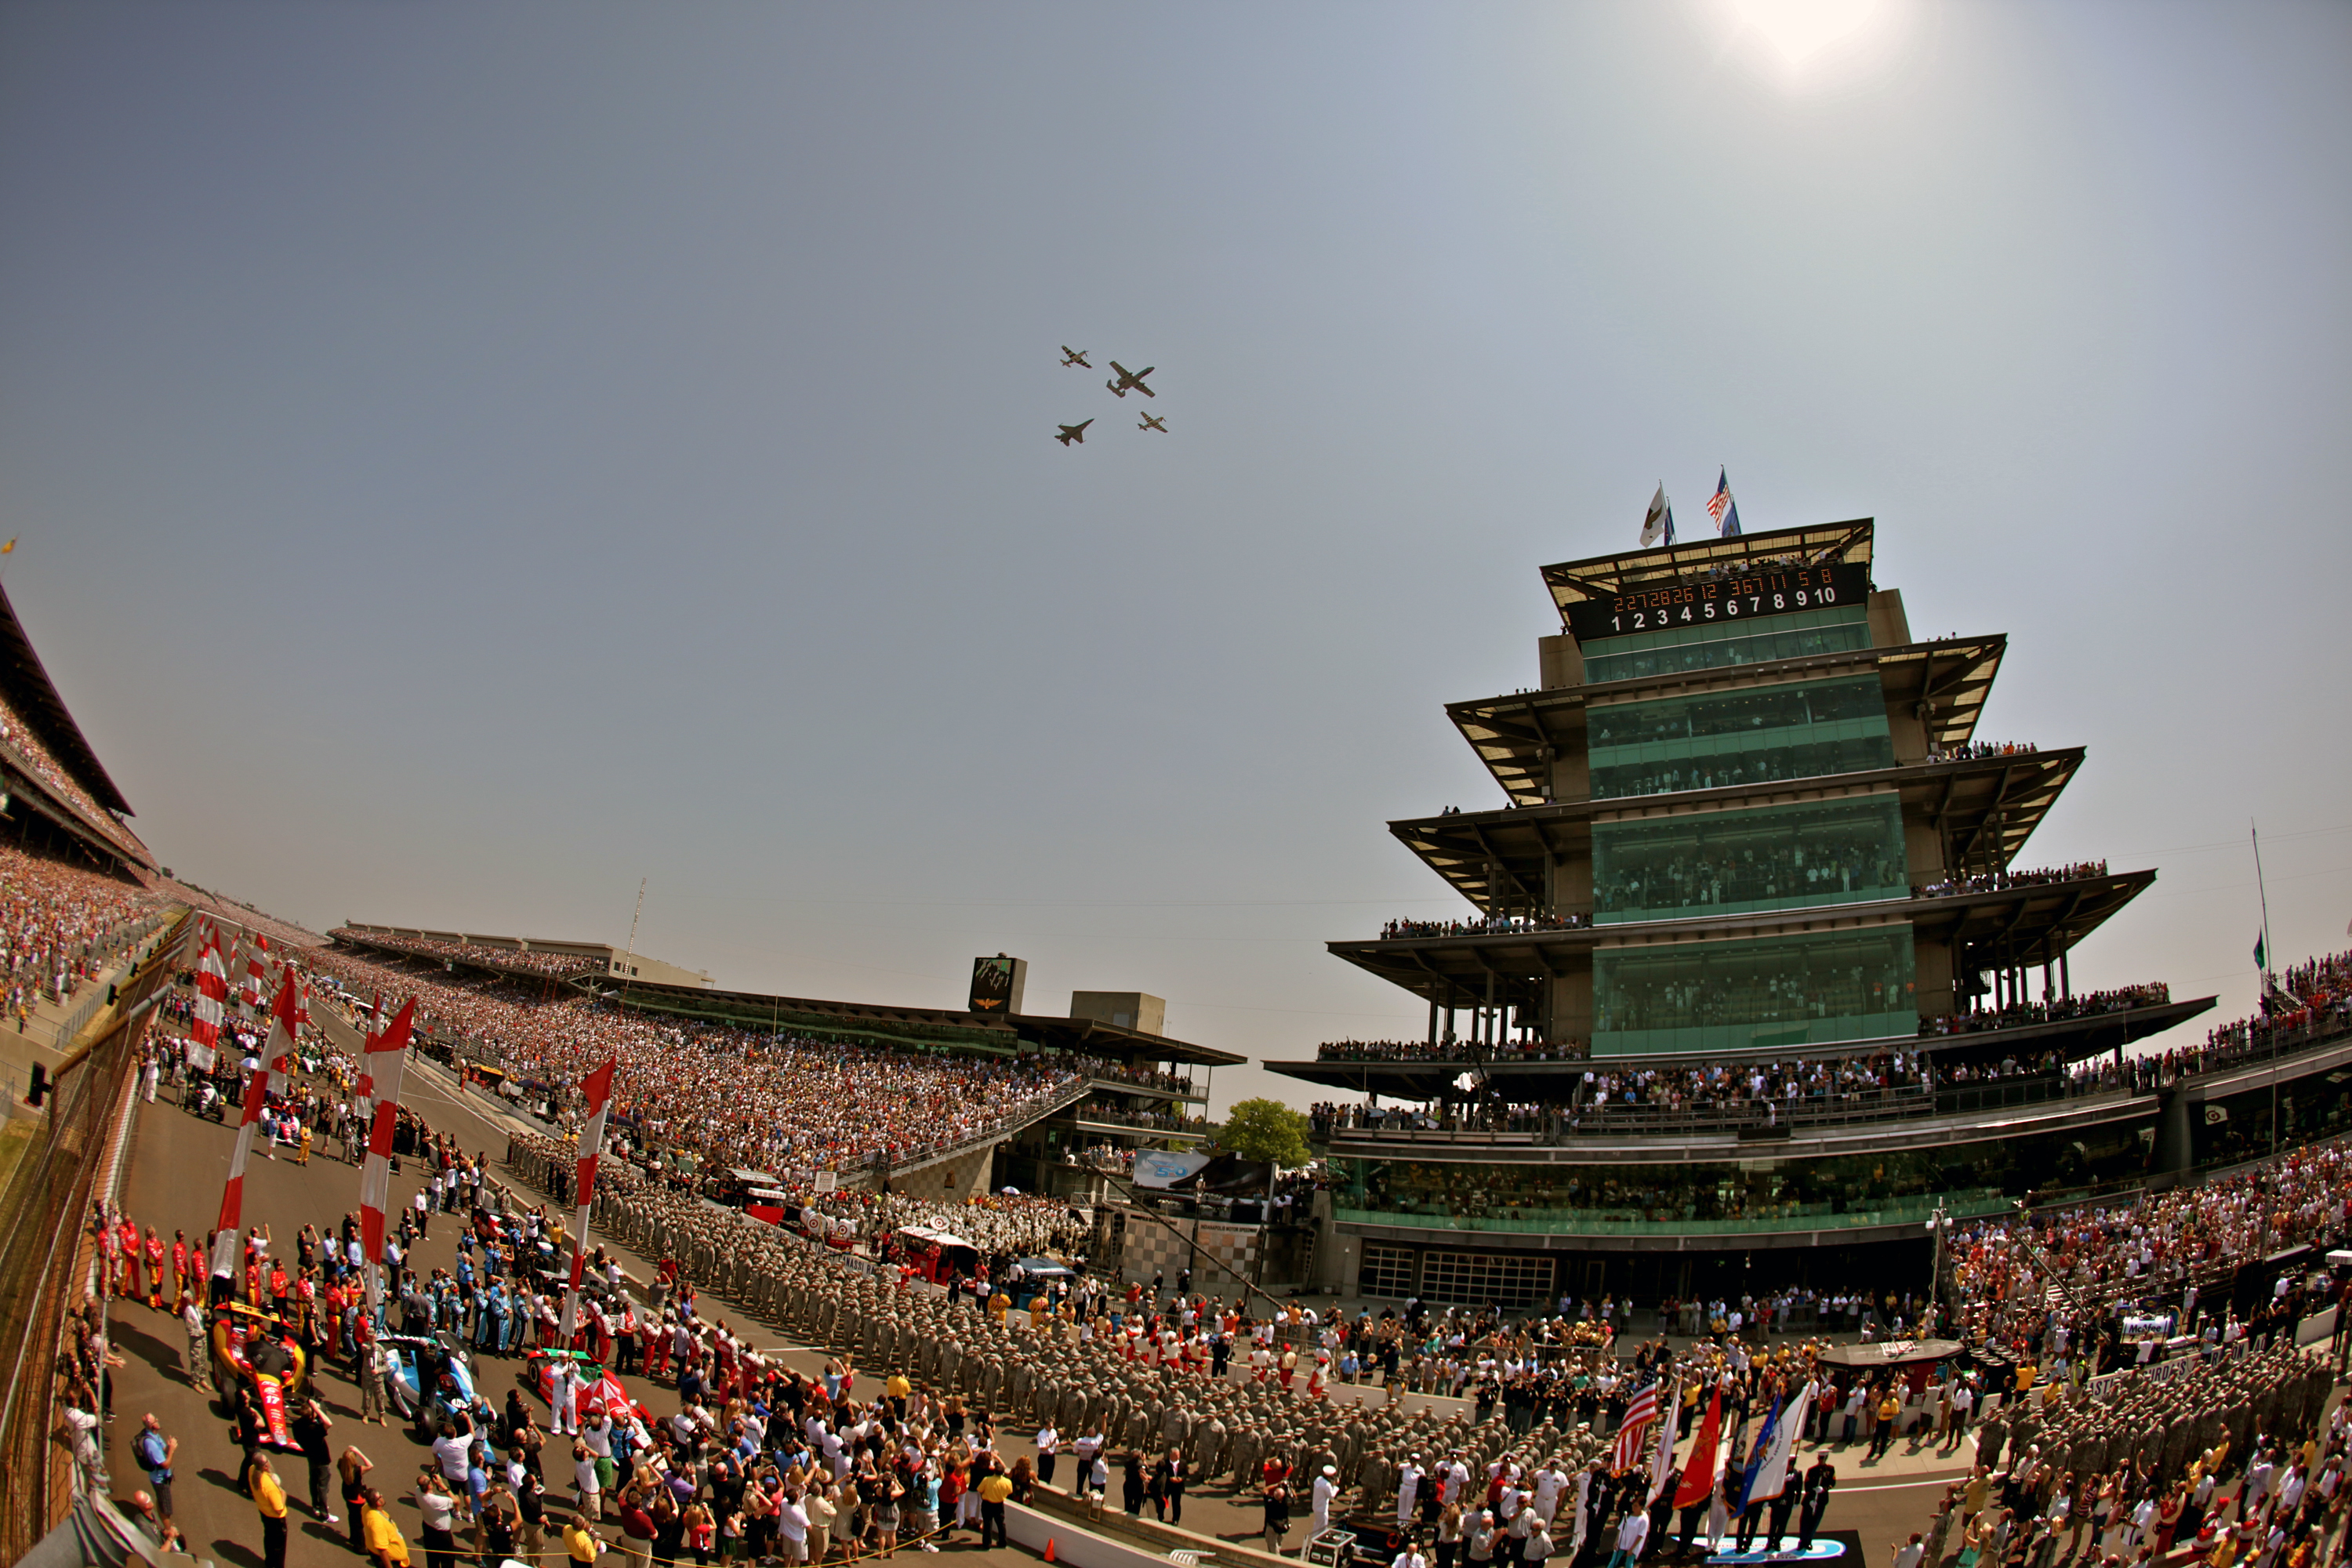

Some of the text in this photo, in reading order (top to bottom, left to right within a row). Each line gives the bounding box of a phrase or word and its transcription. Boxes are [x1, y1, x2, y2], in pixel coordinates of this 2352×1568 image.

[1613, 568, 1832, 612] 2 27 28 26 12 3 67 11 5 8
[1611, 587, 1835, 631] 1 2 3 4 5 6 7 8 9 10
[2129, 1323, 2161, 1334] McAfee
[266, 1396, 280, 1404] 17
